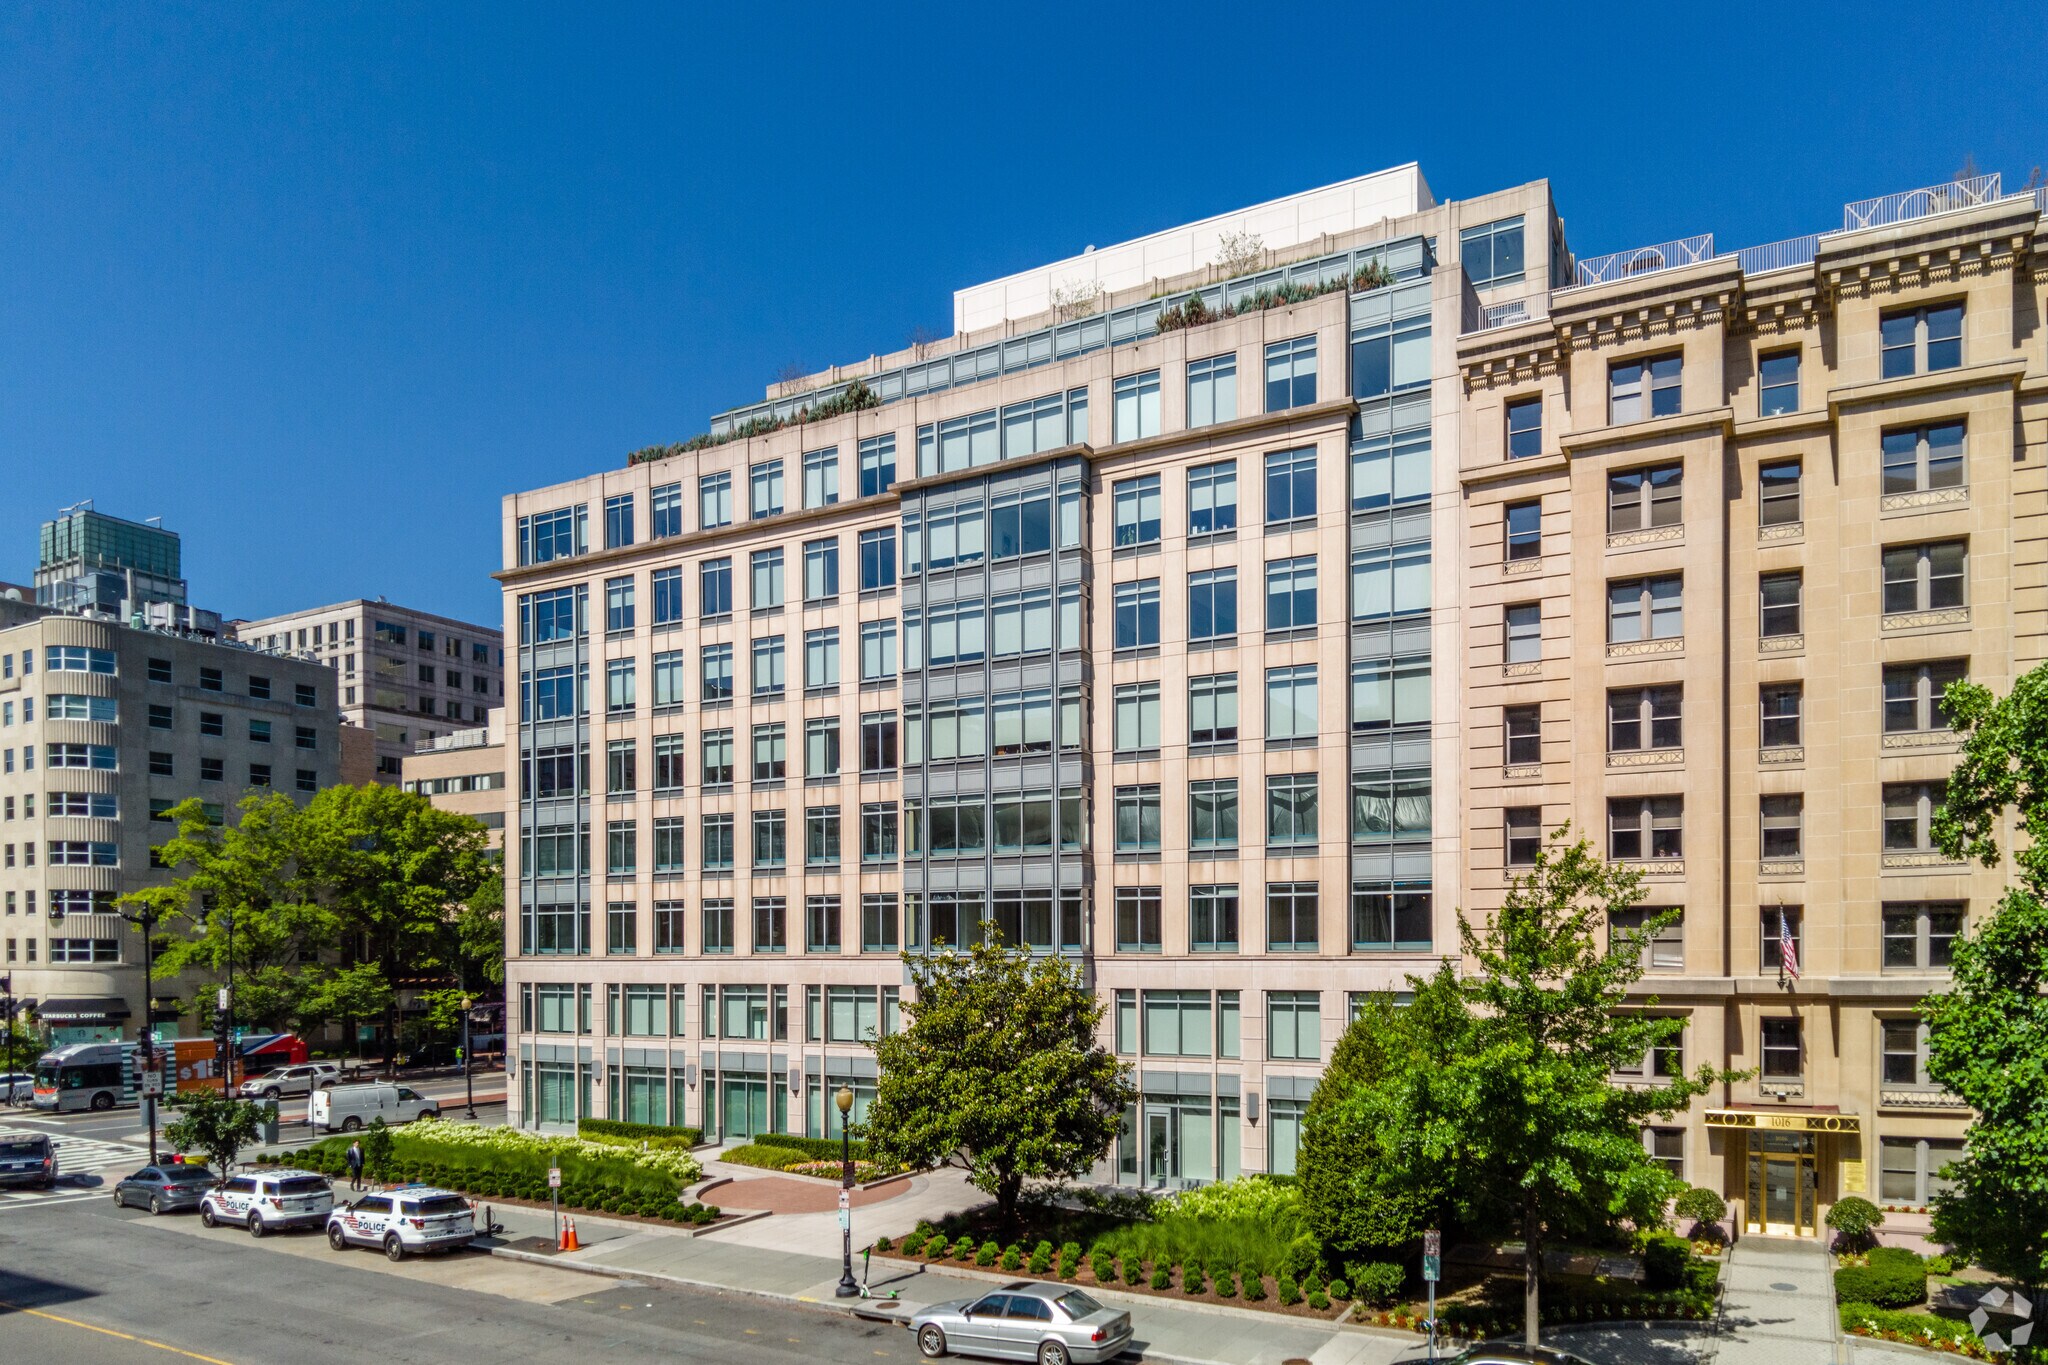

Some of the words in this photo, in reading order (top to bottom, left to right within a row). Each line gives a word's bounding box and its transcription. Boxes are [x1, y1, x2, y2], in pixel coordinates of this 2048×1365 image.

[1771, 1117, 1791, 1127] 1016
[226, 1200, 249, 1210] POLICE
[358, 1221, 386, 1232] POLICE
